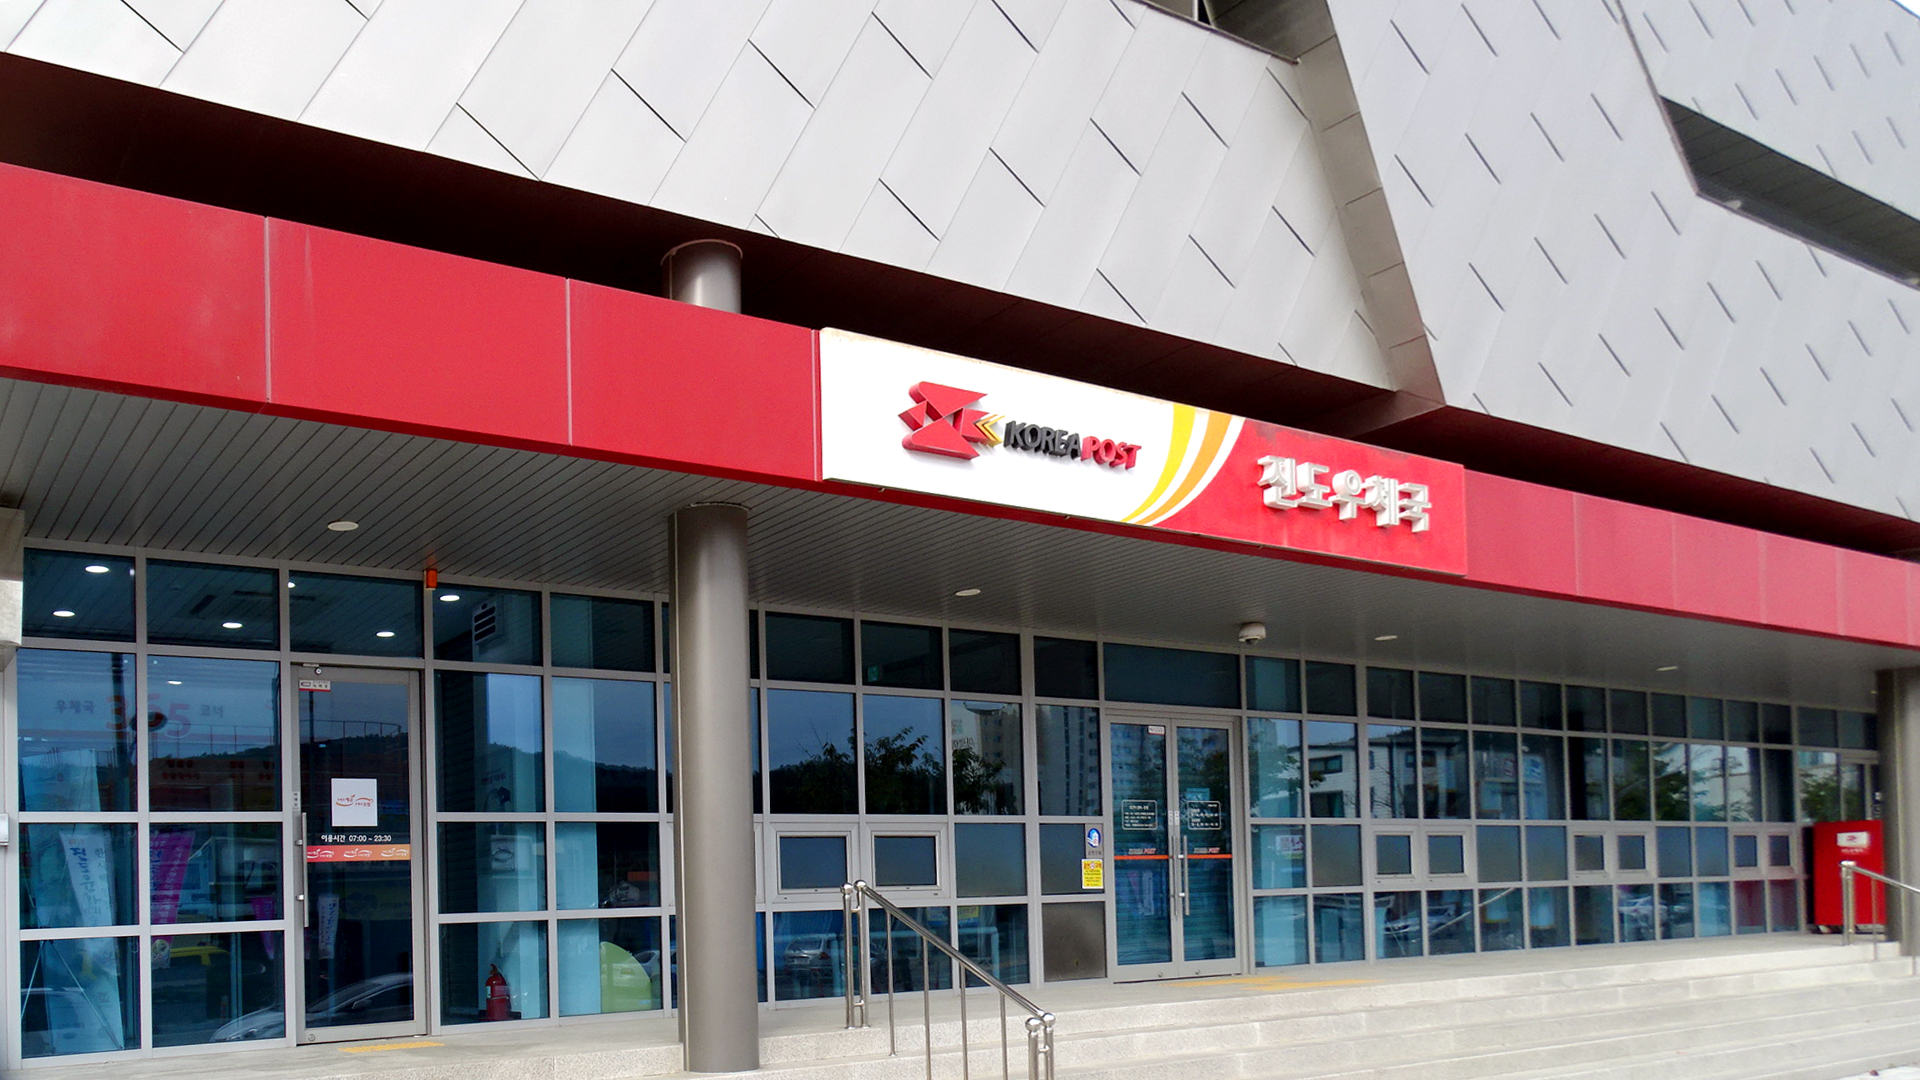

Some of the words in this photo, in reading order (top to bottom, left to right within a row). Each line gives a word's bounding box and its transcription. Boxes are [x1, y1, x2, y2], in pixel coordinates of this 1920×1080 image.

[1003, 420, 1082, 460] KOREA
[1081, 435, 1142, 471] POST
[1257, 455, 1432, 533] 진도우체국
[54, 700, 95, 714] 우체국
[200, 704, 224, 718] 코너
[321, 834, 346, 843] 이용시간
[349, 834, 367, 842] 07:00
[374, 834, 392, 842] 23:30
